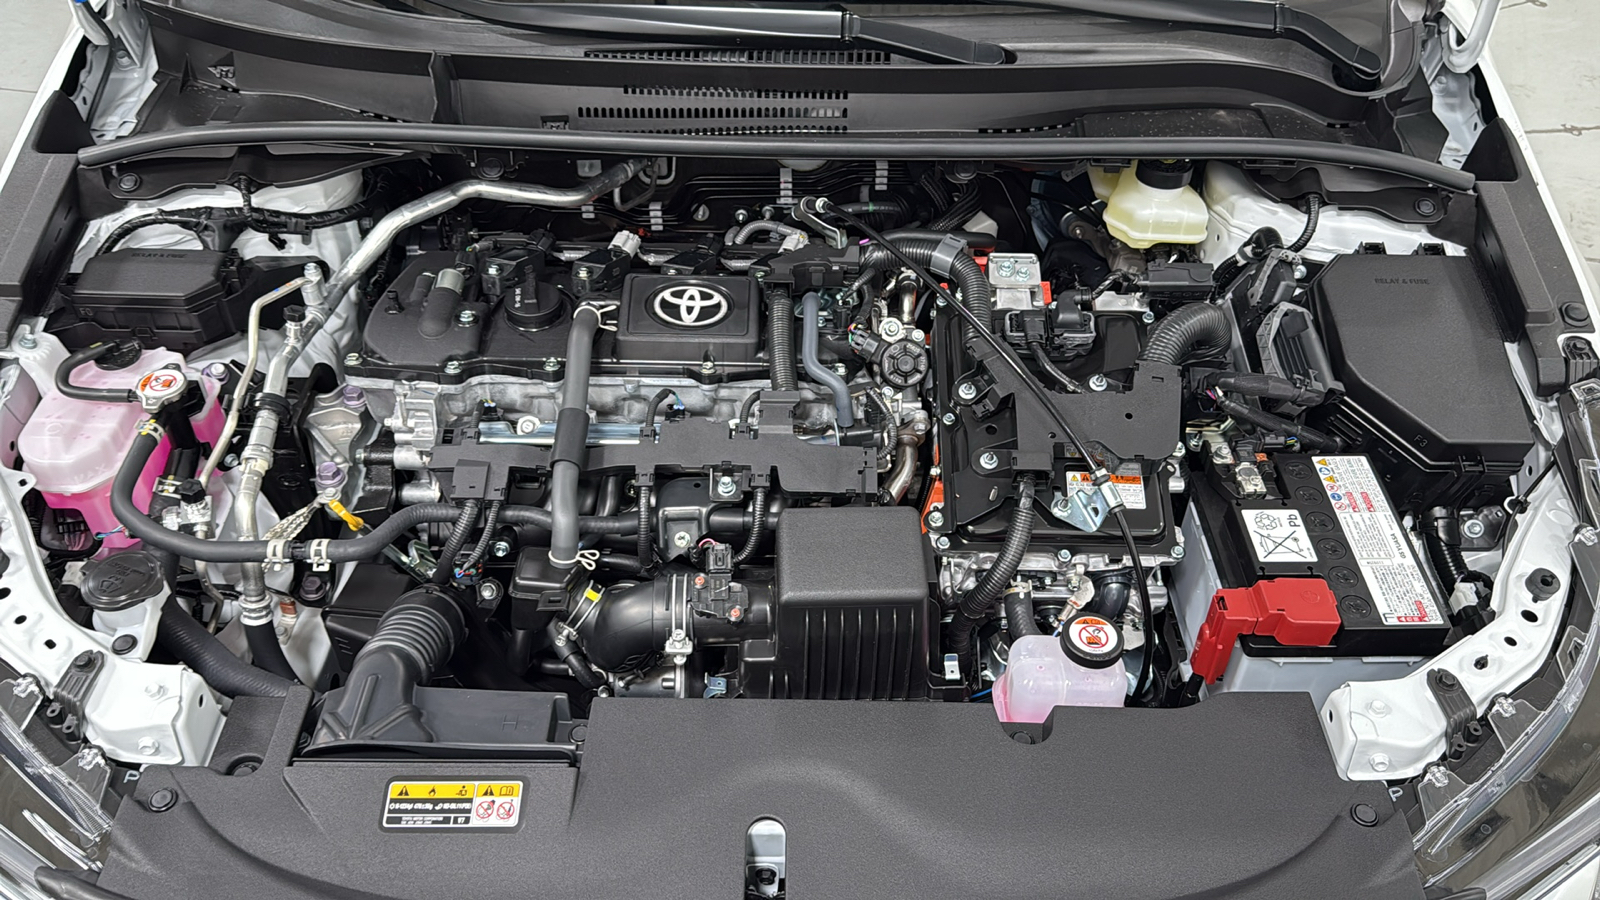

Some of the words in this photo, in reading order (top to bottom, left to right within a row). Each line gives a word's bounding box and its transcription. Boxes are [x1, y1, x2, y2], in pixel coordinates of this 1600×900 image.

[1374, 277, 1399, 285] RELAY
[1413, 434, 1428, 447] F3
[1287, 514, 1301, 527] Pb
[1390, 533, 1403, 551] YUASA
[123, 770, 140, 783] P
[1389, 787, 1403, 801] P
